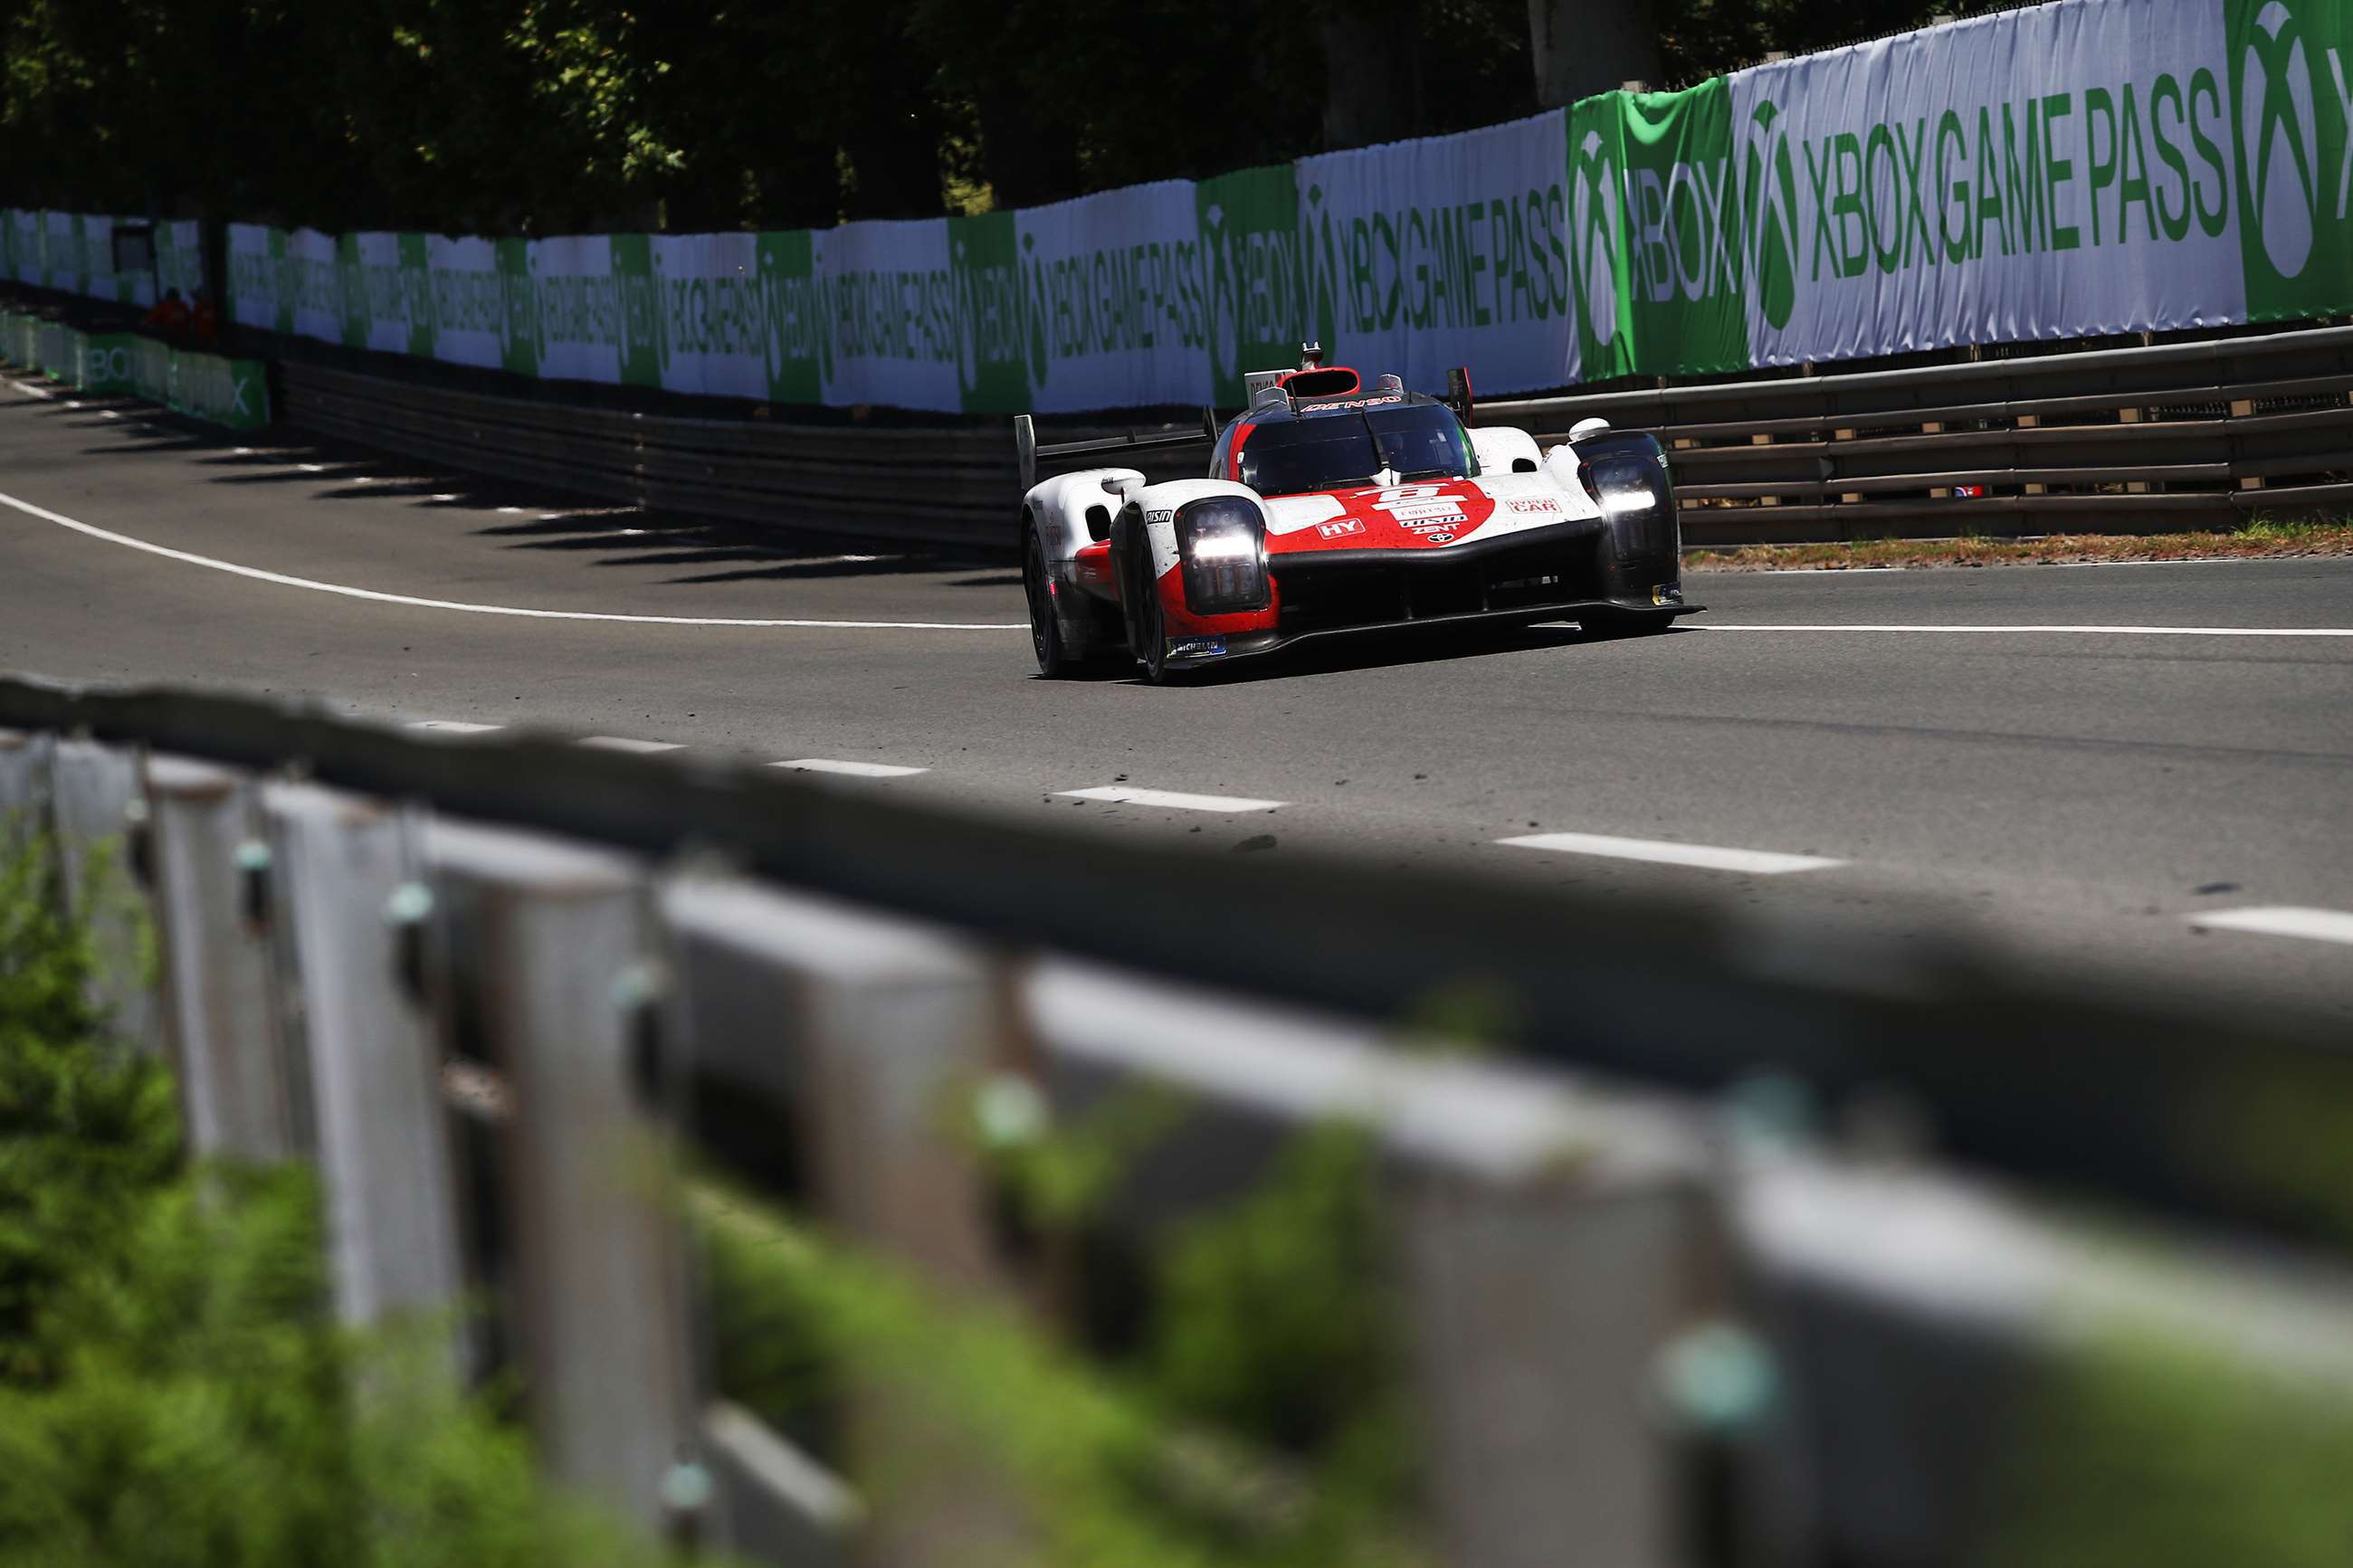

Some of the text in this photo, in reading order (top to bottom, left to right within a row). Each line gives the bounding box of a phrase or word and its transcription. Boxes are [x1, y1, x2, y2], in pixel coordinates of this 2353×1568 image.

[1804, 118, 1935, 281] XBOX
[1936, 93, 2081, 264] GAME
[2086, 68, 2229, 247] PASS
[1624, 157, 1737, 302] XBOX
[1338, 184, 1568, 333] XBOX GAME PASS
[1300, 395, 1402, 413] DENSO
[1513, 503, 1558, 512] CAR
[1146, 510, 1172, 523] AISIN
[1319, 520, 1358, 537] HY
[1411, 523, 1461, 535] ZENT
